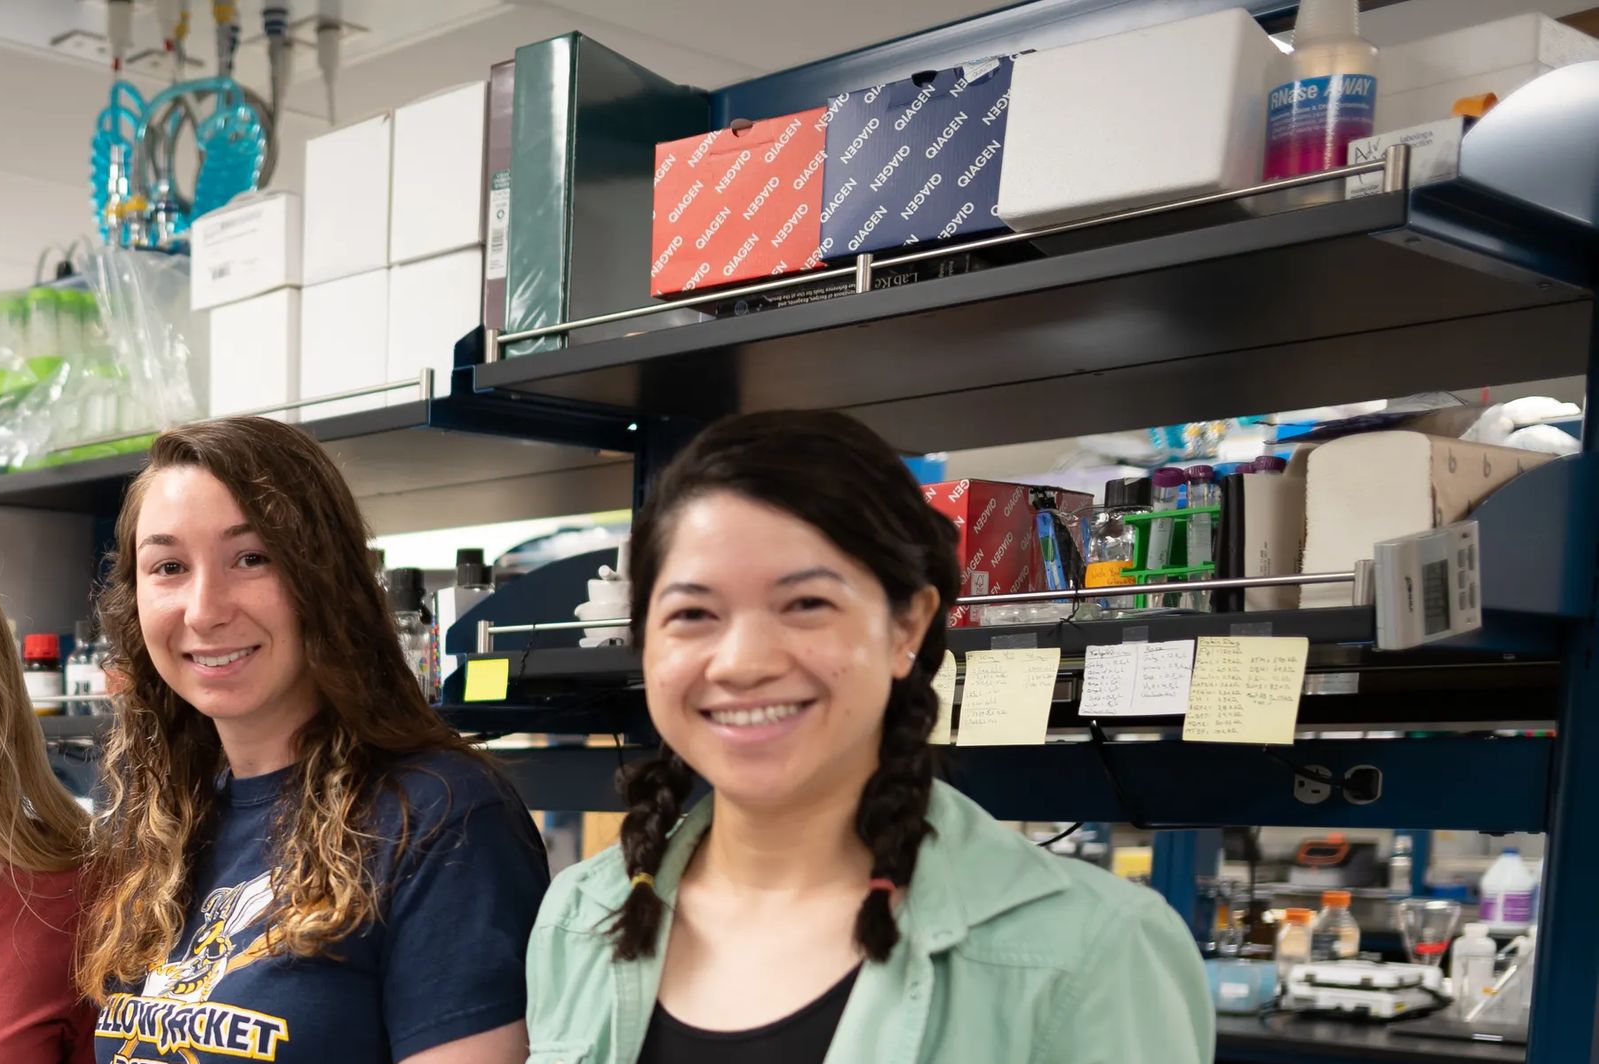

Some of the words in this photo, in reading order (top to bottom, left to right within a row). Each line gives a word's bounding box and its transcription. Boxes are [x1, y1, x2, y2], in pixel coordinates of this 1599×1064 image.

[864, 83, 886, 104] QIA
[894, 84, 936, 131] QIAGEN
[982, 89, 1011, 126] AGEN
[1270, 82, 1318, 110] RNase
[764, 118, 802, 164] QIAGEN
[840, 118, 880, 165] QIAGEN
[925, 111, 968, 160] QIAGEN
[714, 150, 752, 194] QIAGEN
[869, 145, 910, 192] QIAGEN
[957, 139, 1001, 188] QIAGEN
[668, 180, 704, 223] QIAGEN
[742, 176, 780, 221] QIAGEN
[820, 177, 858, 224] QIAGEN
[900, 173, 942, 221] QIAGEN
[695, 206, 731, 250] QIAGEN
[771, 203, 809, 248] QIAGEN
[848, 205, 888, 252] QIAGEN
[937, 202, 975, 240] QIAGE
[650, 235, 683, 278] QIAGEN
[682, 262, 711, 292] QIAG
[723, 233, 760, 277] QIAGEN
[894, 272, 919, 285] Lab
[948, 479, 970, 503] GEN
[973, 498, 997, 535] QIAGEN
[991, 532, 1013, 568] QIAGEN
